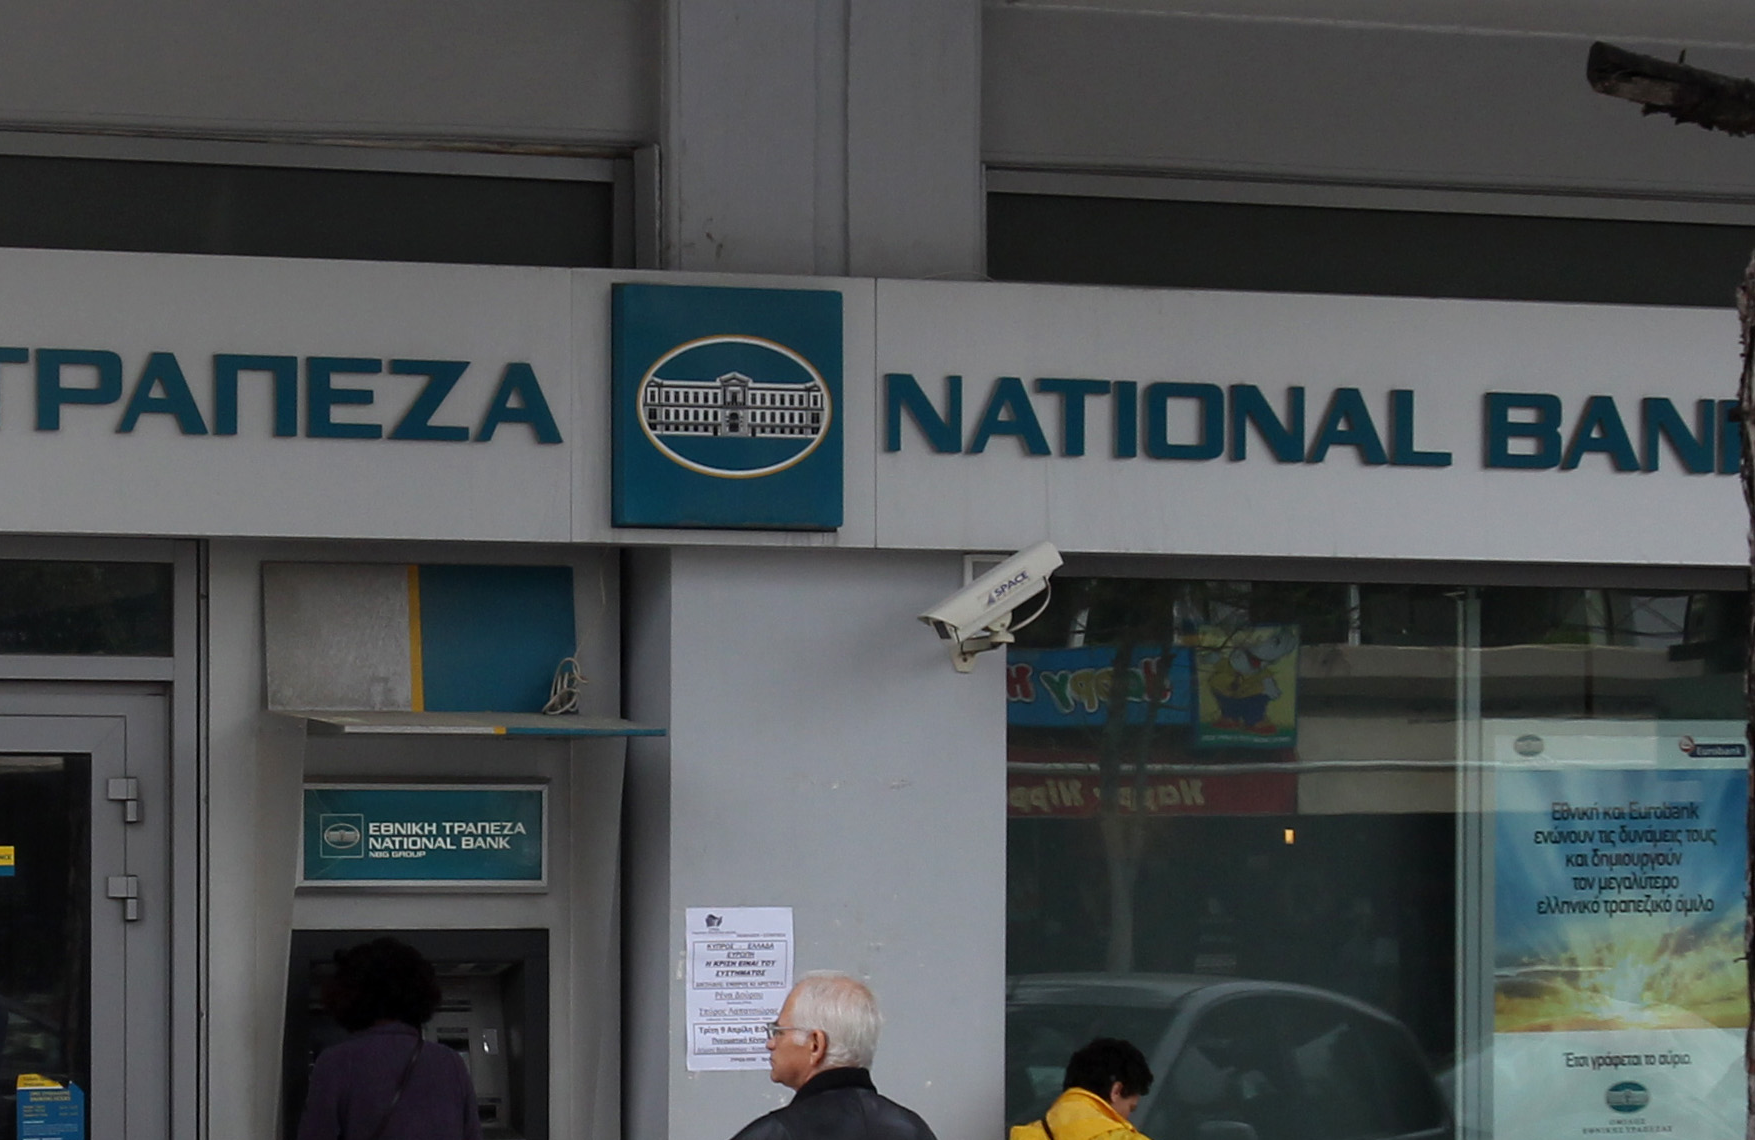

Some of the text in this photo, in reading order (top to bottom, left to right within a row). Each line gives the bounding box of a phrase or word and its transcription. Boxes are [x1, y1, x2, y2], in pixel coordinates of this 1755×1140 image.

[883, 372, 1453, 468] NATIONAL
[993, 570, 1029, 598] SPACE
[1552, 801, 1700, 821] Εθνική και Eurobank
[368, 821, 527, 836] ΕΘΝΙΚΗ ΤΡΑΠΕΖΑ
[1533, 825, 1717, 848] ενώνουν τις δυνάμεις τους
[368, 836, 512, 850] NATIONAL BANK
[1565, 848, 1683, 871] και δημιουργούν
[1572, 872, 1680, 895] τον μεγαλύτερο
[1536, 893, 1715, 918] ελληνικό τραπεζικό όμιλο
[1563, 1052, 1590, 1068] Έτσι
[1591, 1051, 1643, 1070] γράφεται
[1644, 1053, 1657, 1068] το
